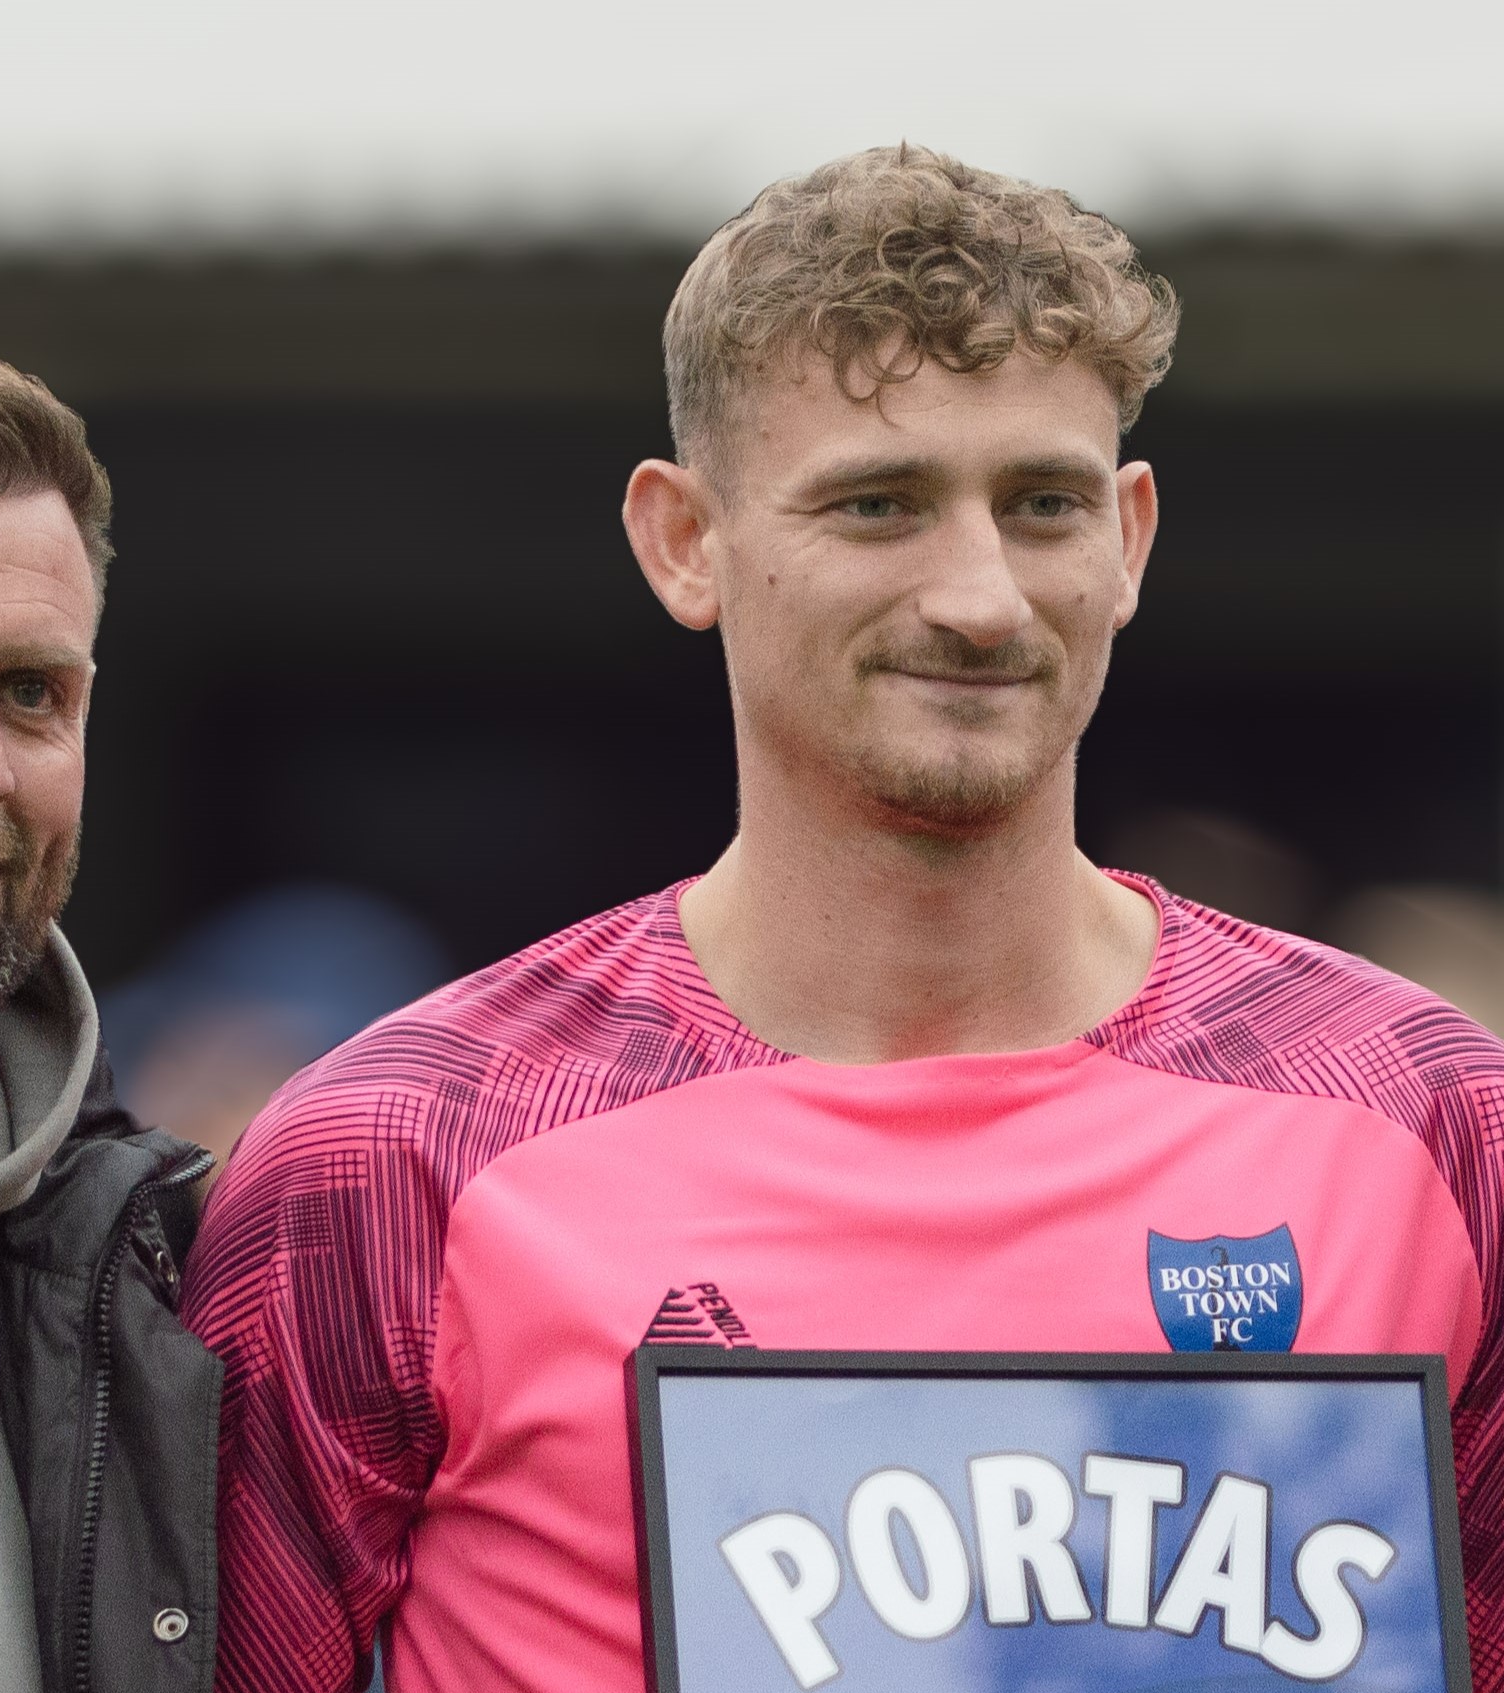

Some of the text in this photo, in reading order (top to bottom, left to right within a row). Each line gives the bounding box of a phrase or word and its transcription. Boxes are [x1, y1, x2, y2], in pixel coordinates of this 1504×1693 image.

[1159, 1262, 1291, 1292] BOSTON
[687, 1282, 757, 1347] PENDL
[1178, 1290, 1278, 1317] TOWN
[1212, 1317, 1253, 1343] FC
[718, 1450, 1395, 1691] PORTAS
